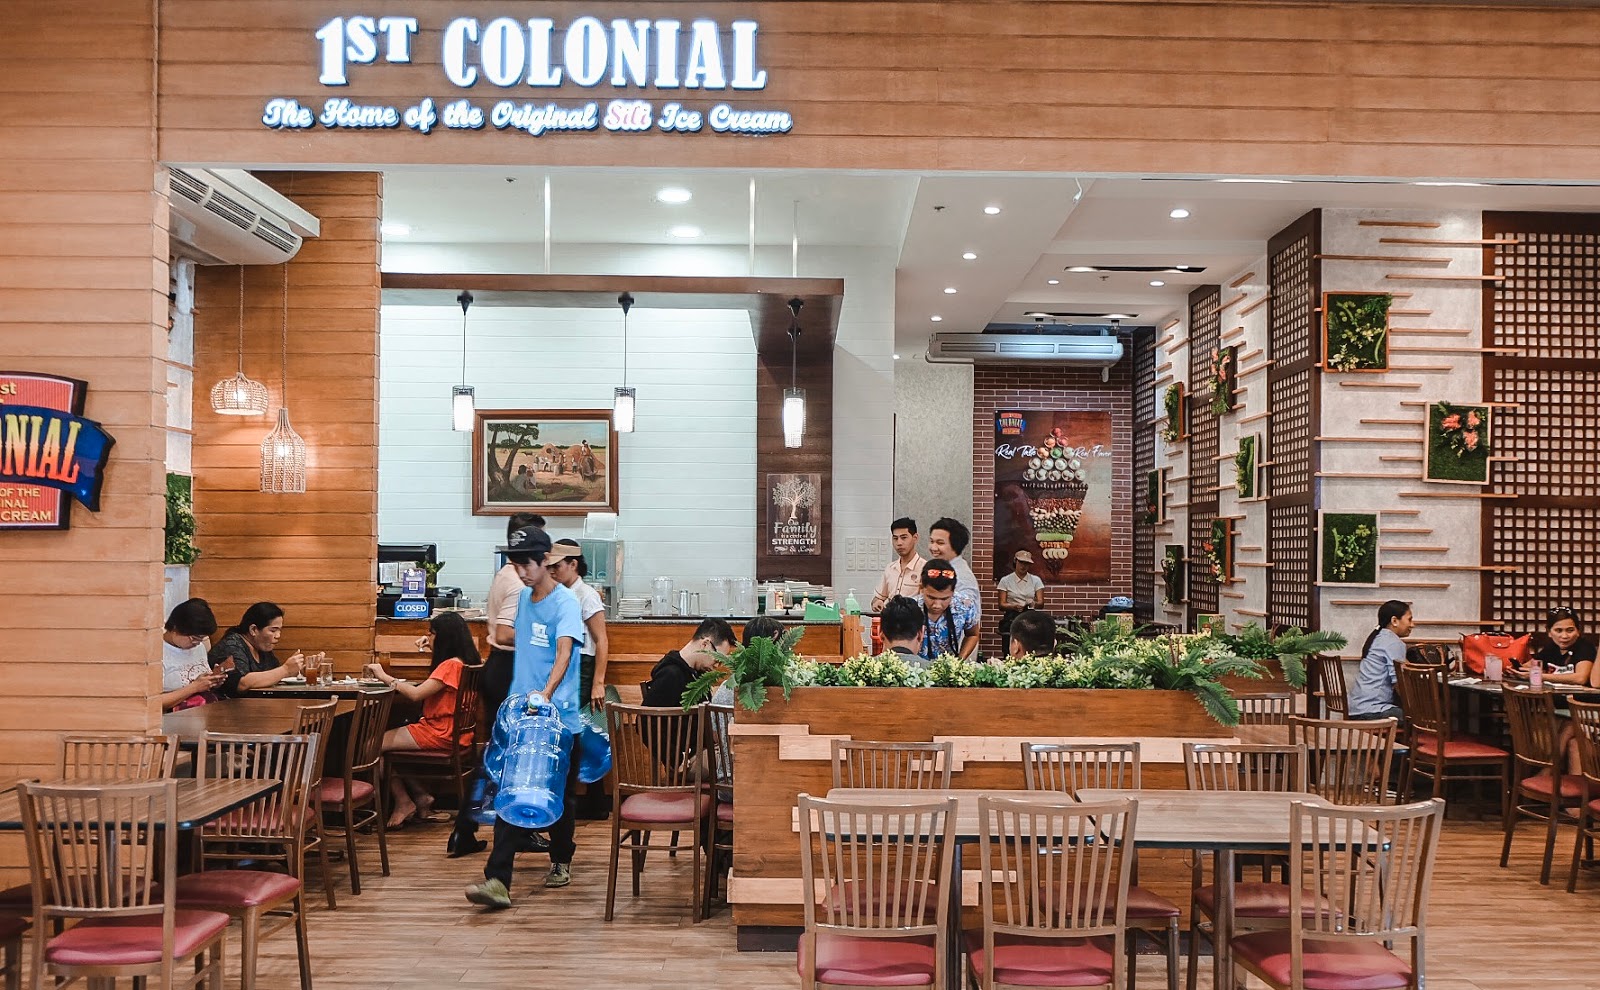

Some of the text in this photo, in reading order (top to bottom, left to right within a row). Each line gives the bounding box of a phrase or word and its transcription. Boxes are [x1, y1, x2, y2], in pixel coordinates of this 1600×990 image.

[315, 17, 768, 89] 1ST COLONIAL
[262, 97, 793, 136] The Home of the Original Sili Ice Cream
[0, 382, 17, 402] st
[0, 413, 82, 484] NIAL
[0, 488, 40, 497] OF THE
[0, 499, 28, 508] INAL
[1, 510, 52, 521] CREAM
[774, 522, 817, 538] Family
[396, 604, 427, 612] CLOSED
